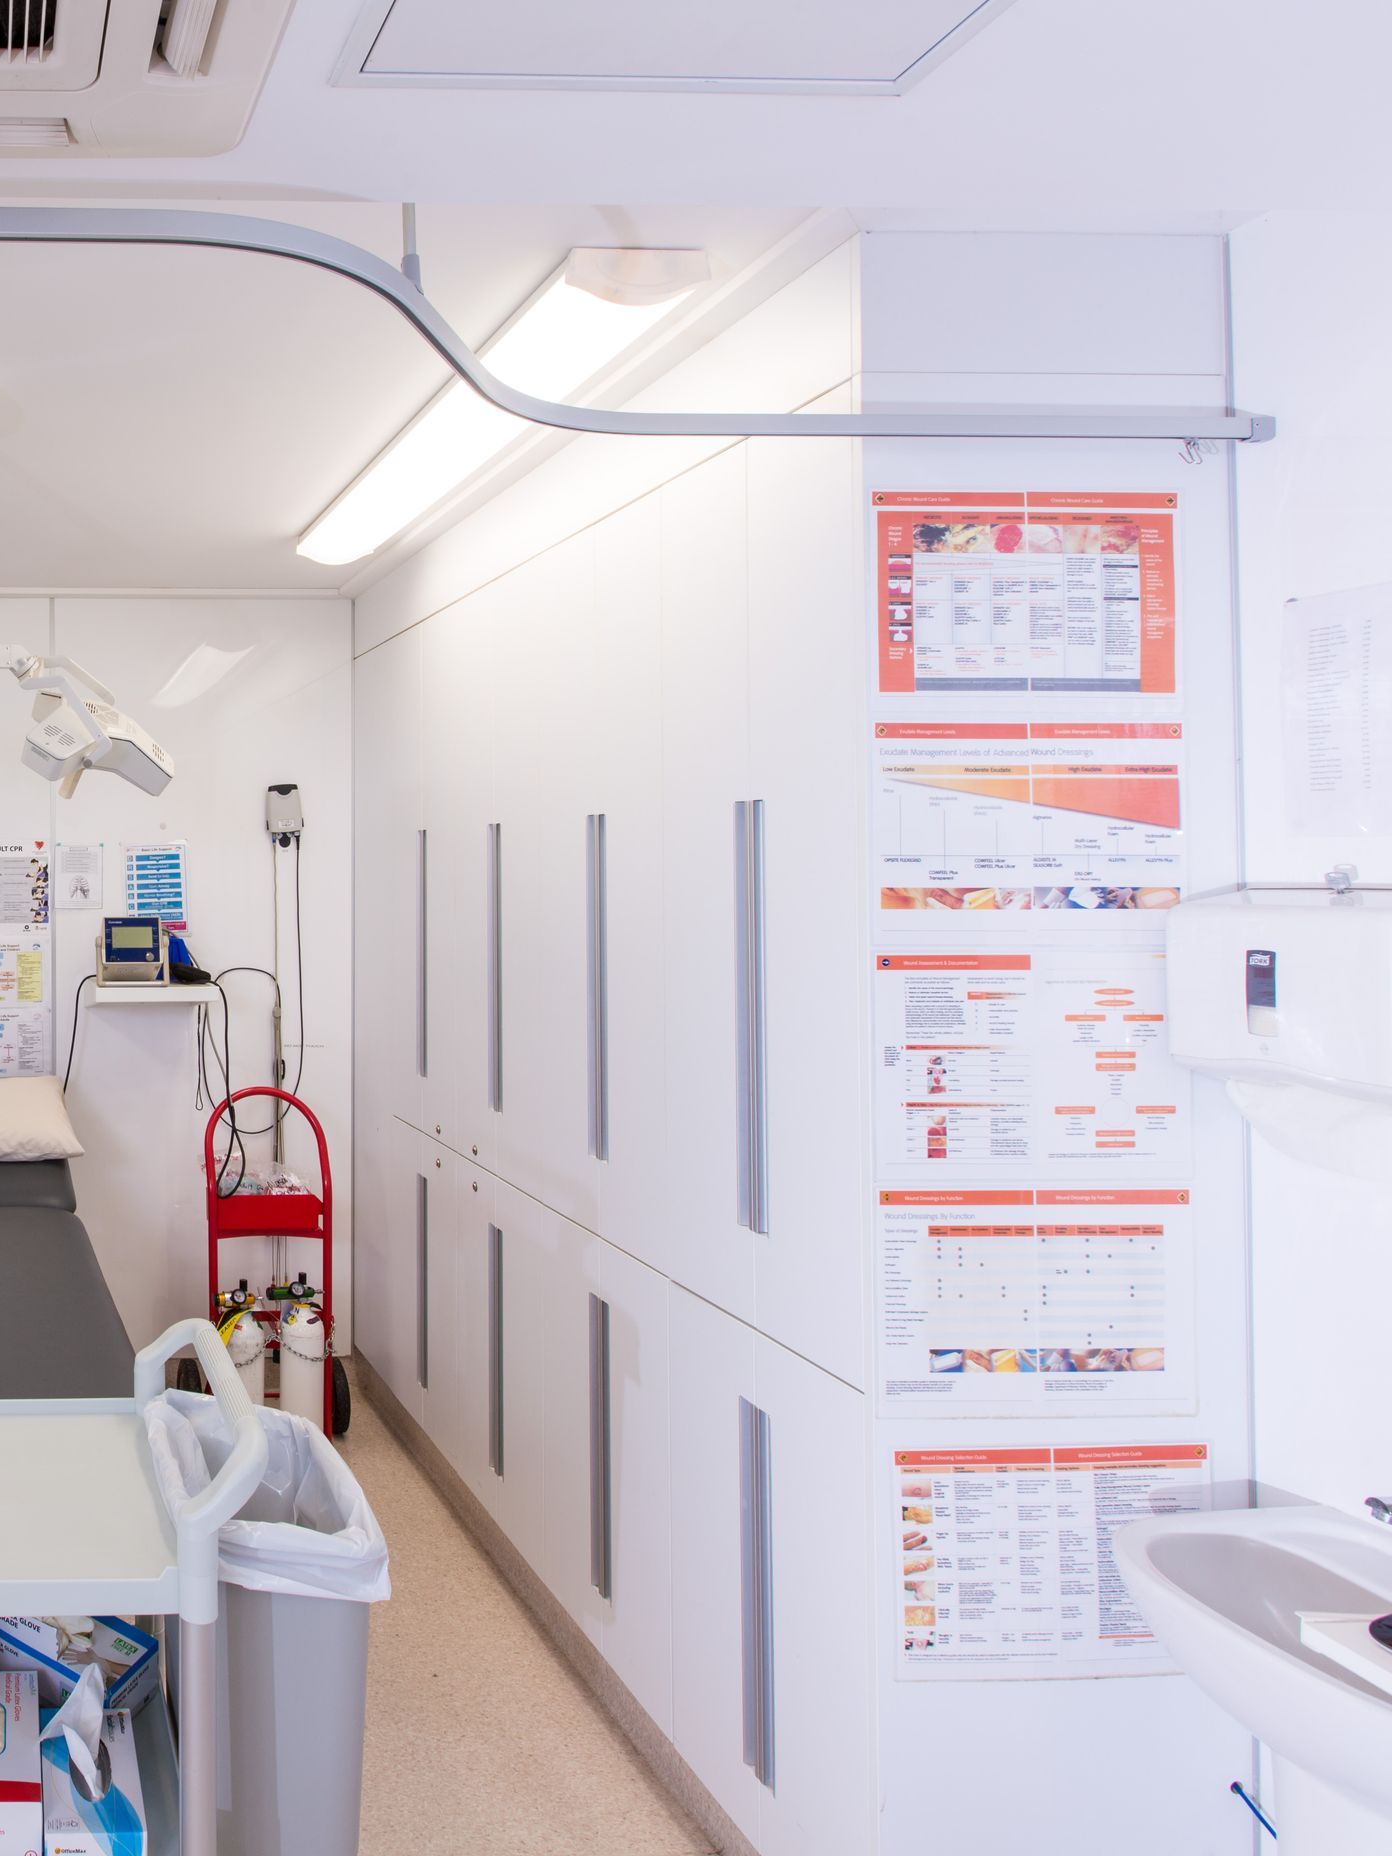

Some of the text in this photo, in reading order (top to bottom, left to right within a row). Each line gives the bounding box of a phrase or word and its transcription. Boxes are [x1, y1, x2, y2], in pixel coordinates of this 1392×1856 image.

[880, 748, 908, 756] Exudate
[910, 748, 957, 758] Management
[960, 748, 981, 756] Levels
[993, 748, 1029, 756] Advanced
[1031, 748, 1056, 756] Wound
[1058, 748, 1093, 757] Dressings
[908, 1213, 938, 1221] Dressings
[940, 1213, 948, 1221] By
[19, 1618, 41, 1633] GLOVE
[4, 1645, 18, 1657] GLOVE
